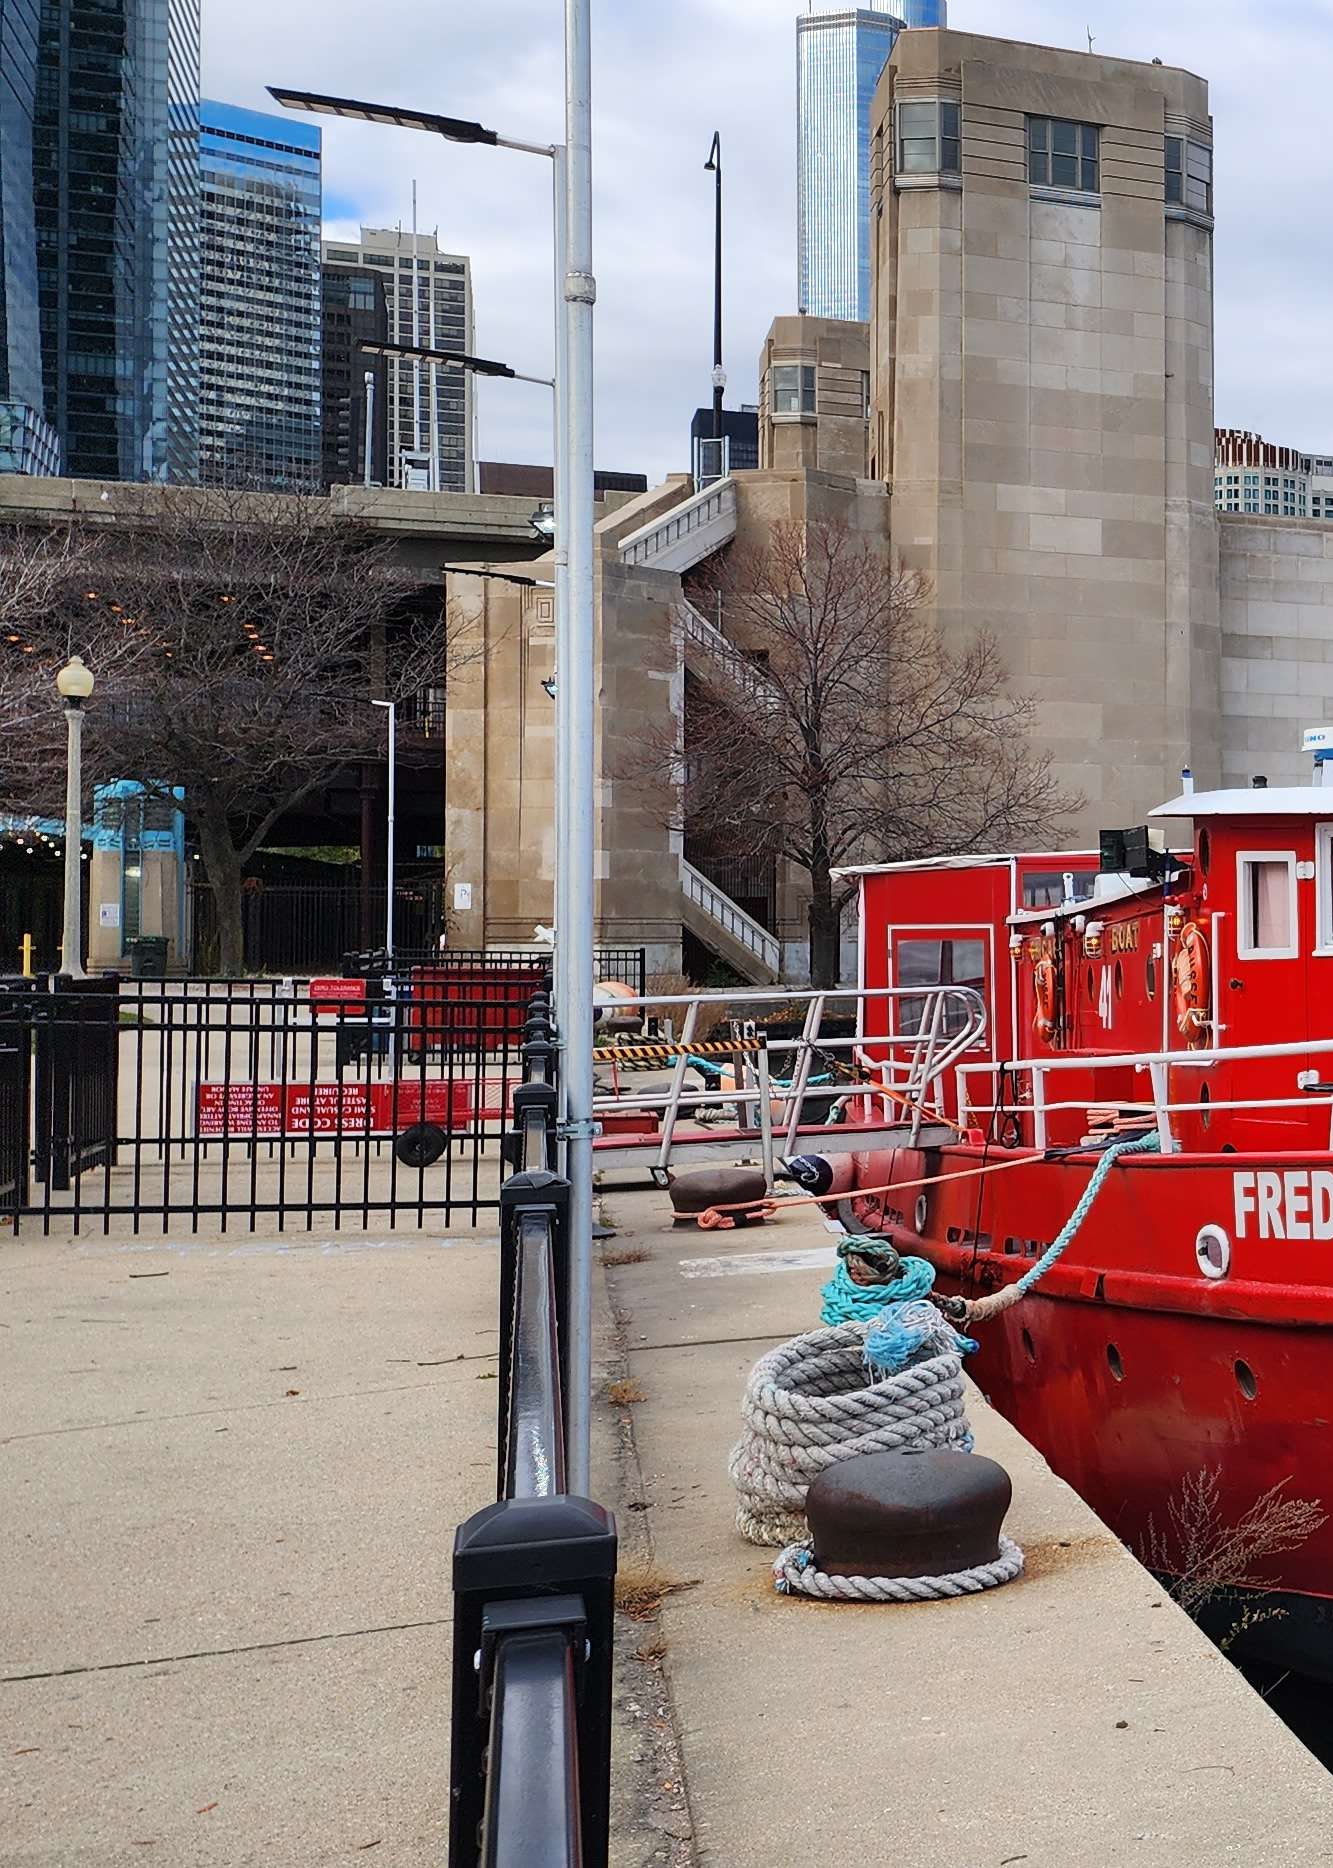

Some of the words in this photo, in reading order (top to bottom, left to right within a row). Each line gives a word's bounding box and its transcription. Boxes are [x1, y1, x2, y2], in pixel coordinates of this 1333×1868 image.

[1111, 920, 1140, 954] BOAT
[1099, 965, 1112, 1030] 41
[295, 1097, 327, 1105] ATIRE
[328, 1096, 372, 1105] ASTEFUL
[354, 1105, 376, 1114] SMI
[291, 1118, 331, 1129] CODE
